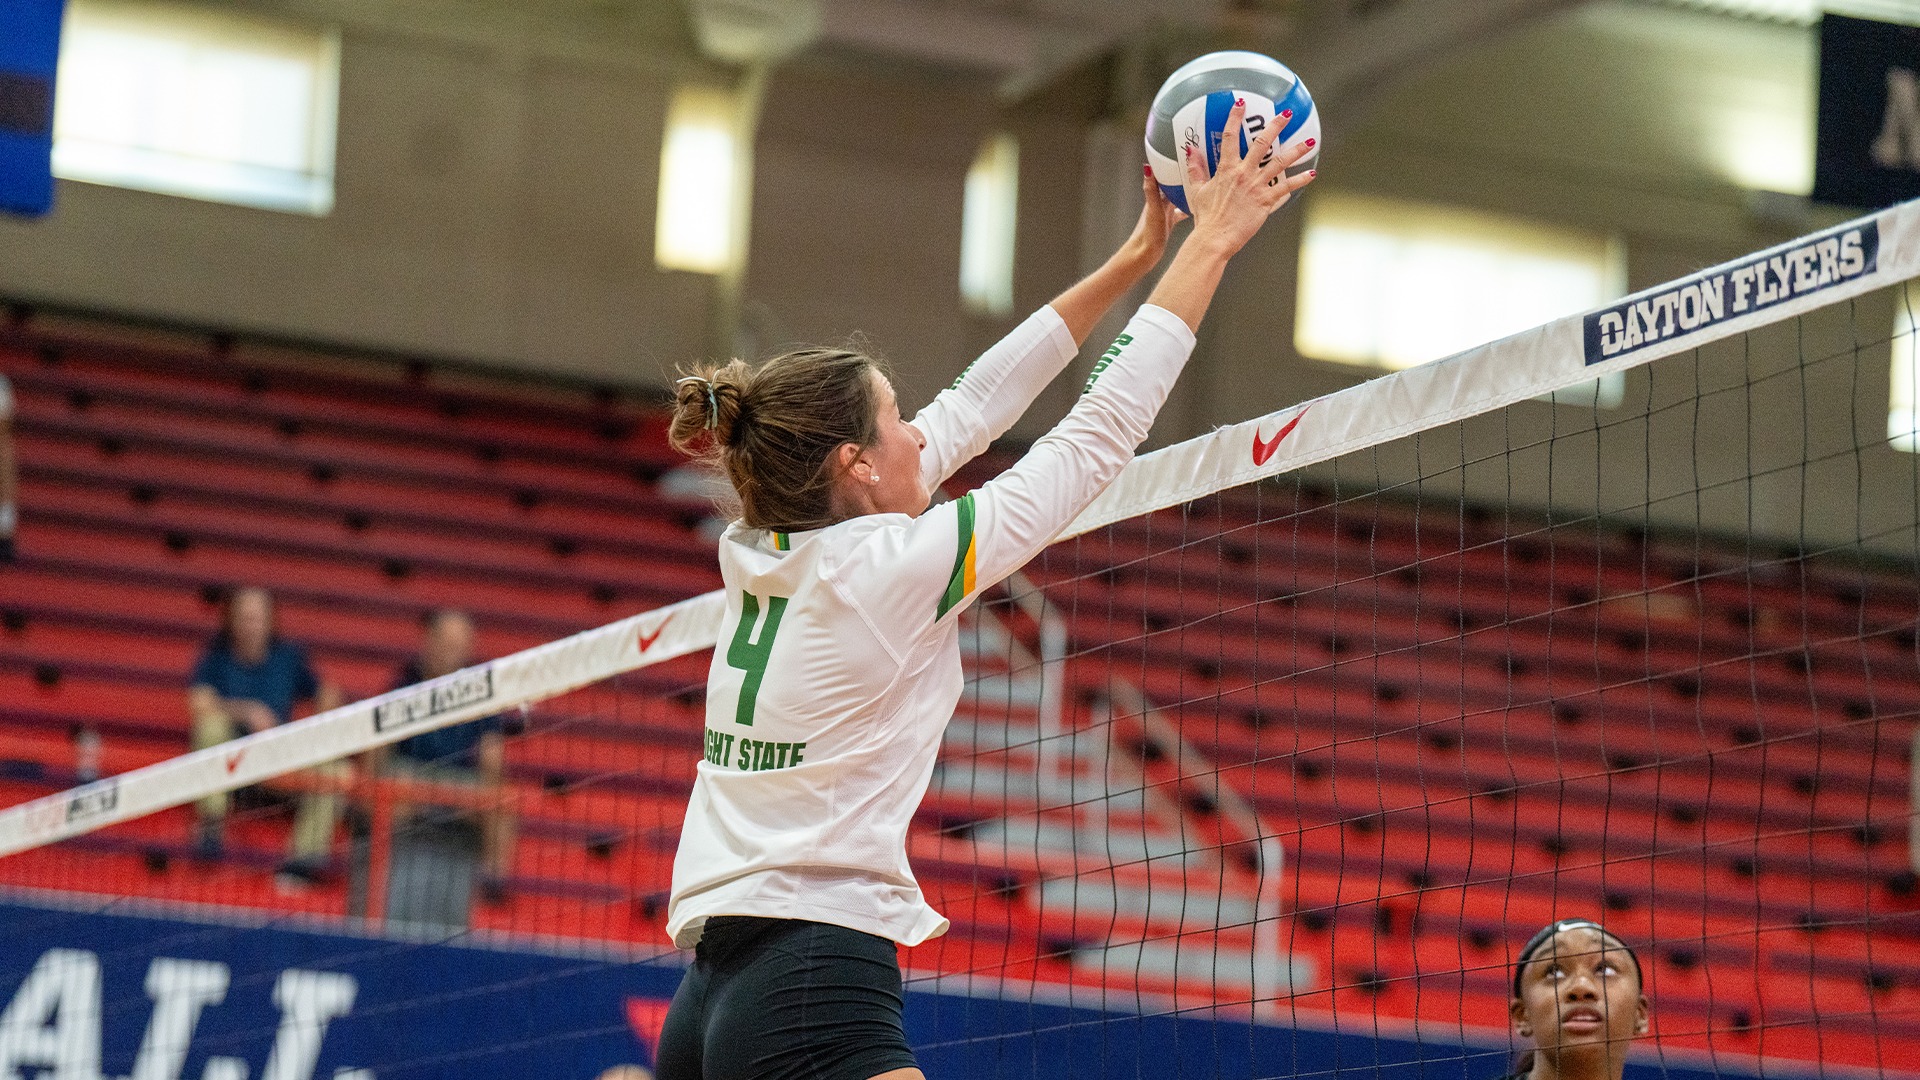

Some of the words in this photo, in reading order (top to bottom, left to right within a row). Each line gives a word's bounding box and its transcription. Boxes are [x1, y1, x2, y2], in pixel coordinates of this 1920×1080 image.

[1599, 276, 1724, 356] DAYTON
[1731, 229, 1865, 313] FLYERS
[727, 589, 789, 727] 4
